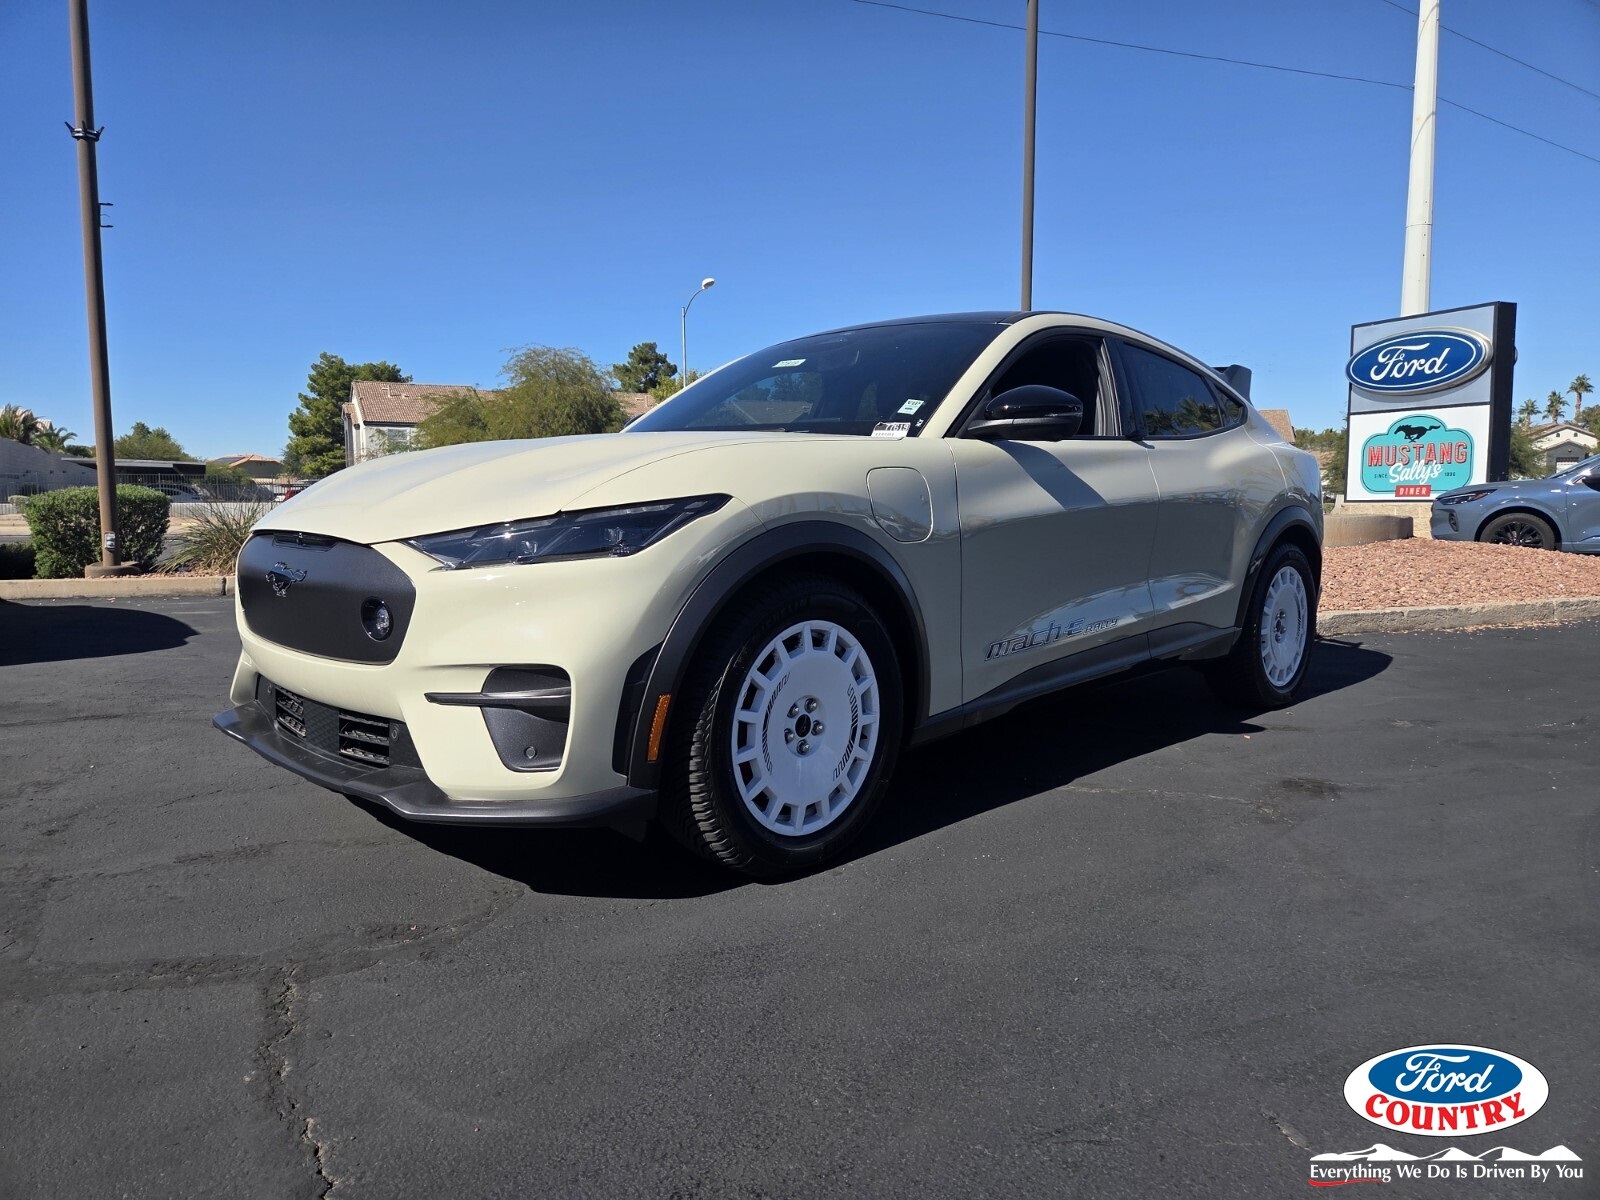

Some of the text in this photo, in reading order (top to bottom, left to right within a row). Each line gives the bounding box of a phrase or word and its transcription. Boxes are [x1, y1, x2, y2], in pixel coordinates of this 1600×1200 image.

[1370, 343, 1450, 381] Ford
[1367, 442, 1468, 467] MUSTANG
[1388, 460, 1444, 484] Sally's
[1399, 487, 1427, 495] DINER
